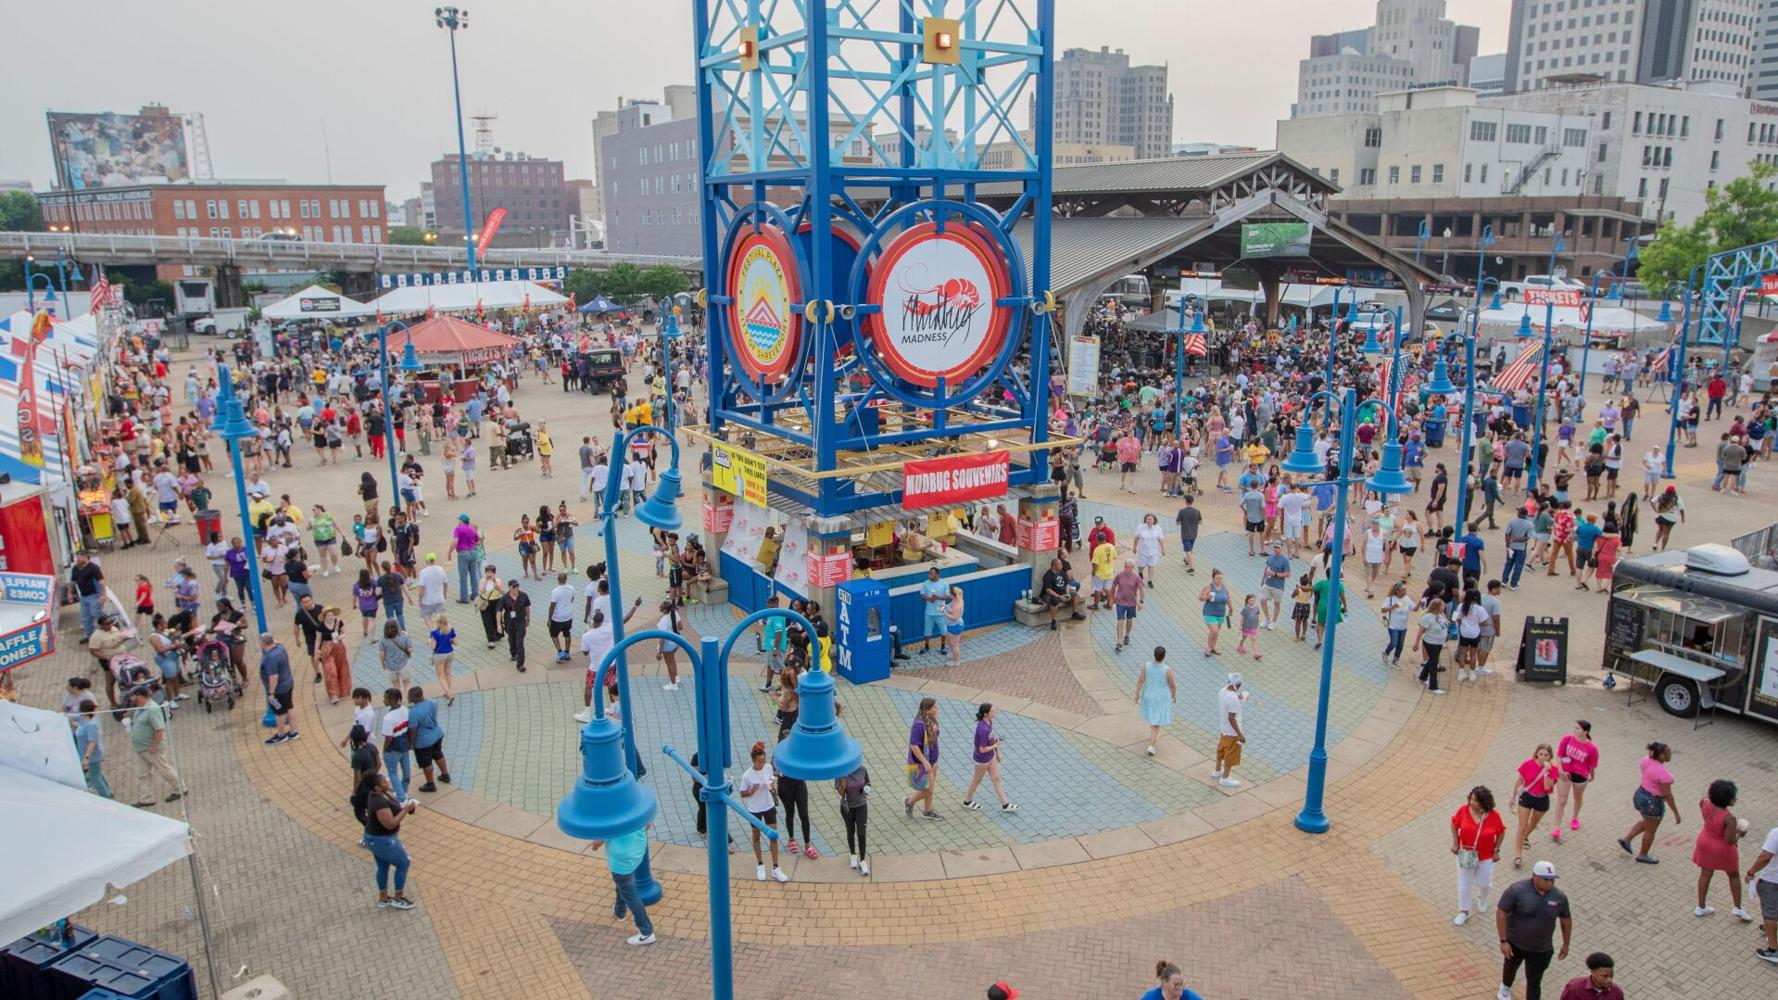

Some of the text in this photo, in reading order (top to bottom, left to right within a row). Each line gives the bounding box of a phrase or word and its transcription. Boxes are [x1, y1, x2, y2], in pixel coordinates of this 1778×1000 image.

[742, 248, 783, 281] FESTIVAL PLAZA
[1527, 290, 1578, 305] TICKETS
[901, 332, 947, 344] MADNESS
[464, 350, 501, 363] TICKETS
[906, 462, 1007, 496] MUDBUG SOUVENIRS
[839, 602, 852, 671] ATM
